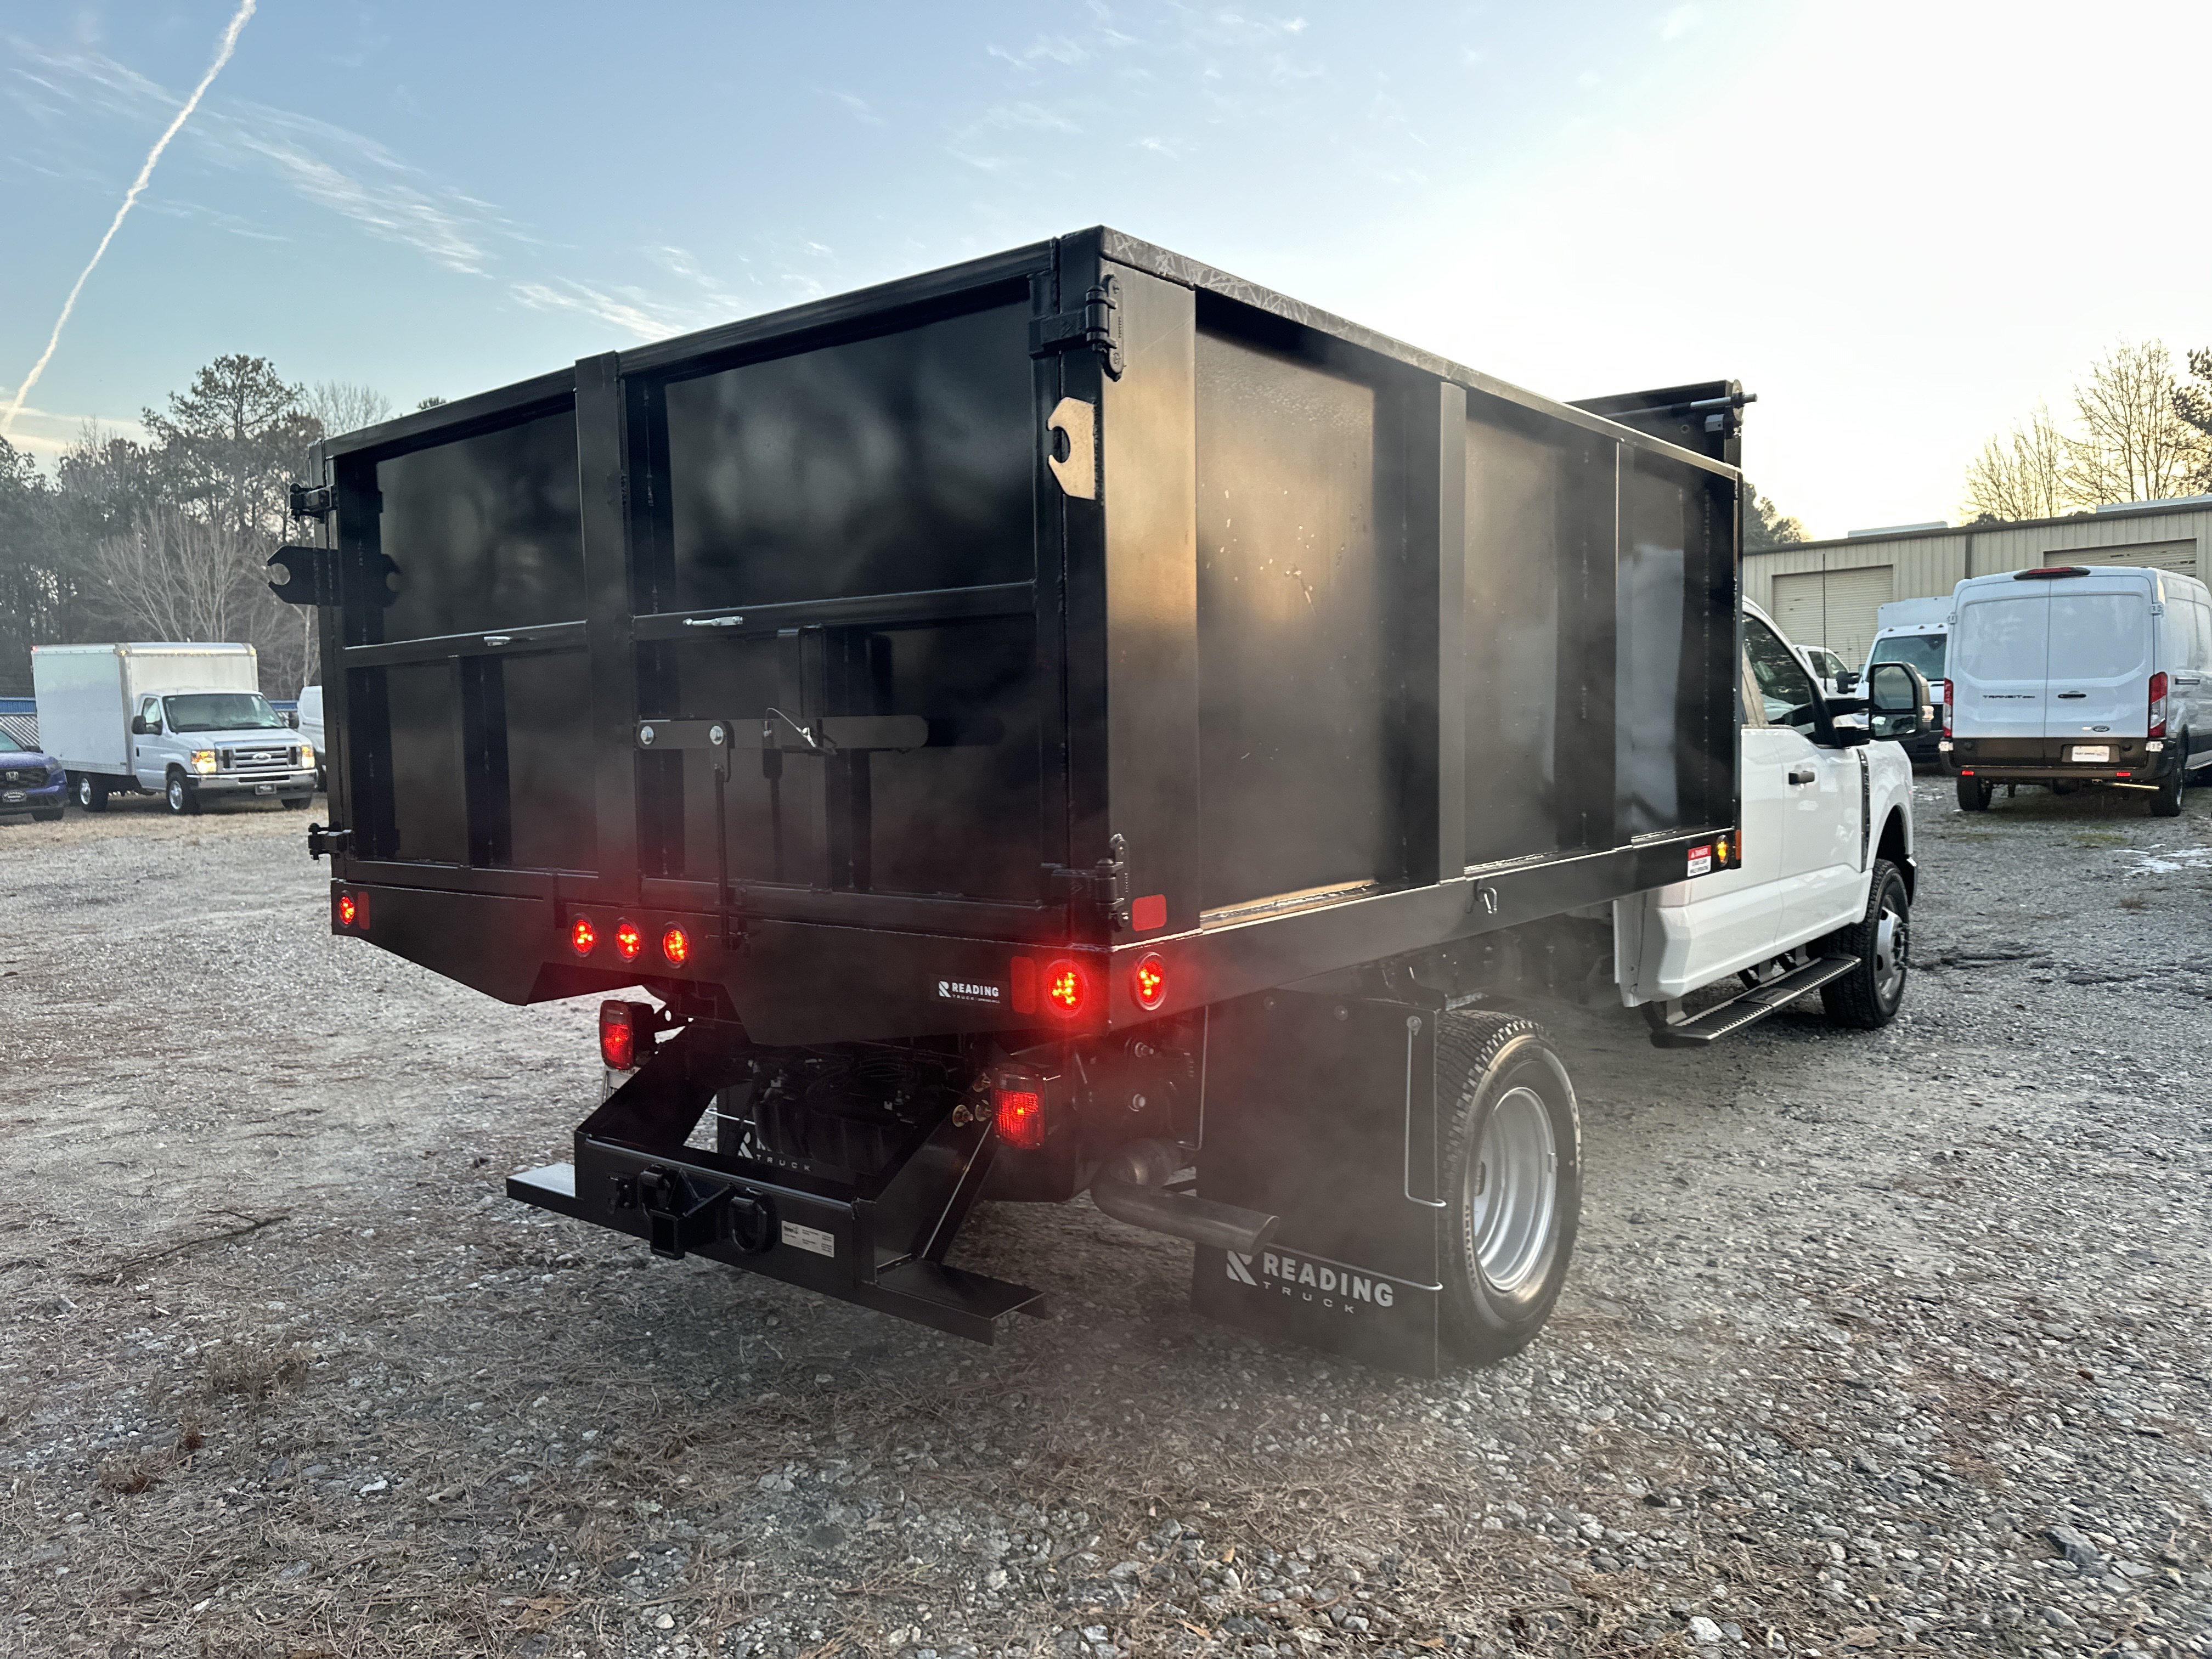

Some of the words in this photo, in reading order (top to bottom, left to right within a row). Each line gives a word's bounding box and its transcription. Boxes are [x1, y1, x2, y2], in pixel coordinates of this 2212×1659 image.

[951, 982, 999, 997] READING
[756, 1154, 811, 1171] TRUCK
[1263, 1252, 1393, 1307] READING
[1263, 1281, 1355, 1314] TRUCK
